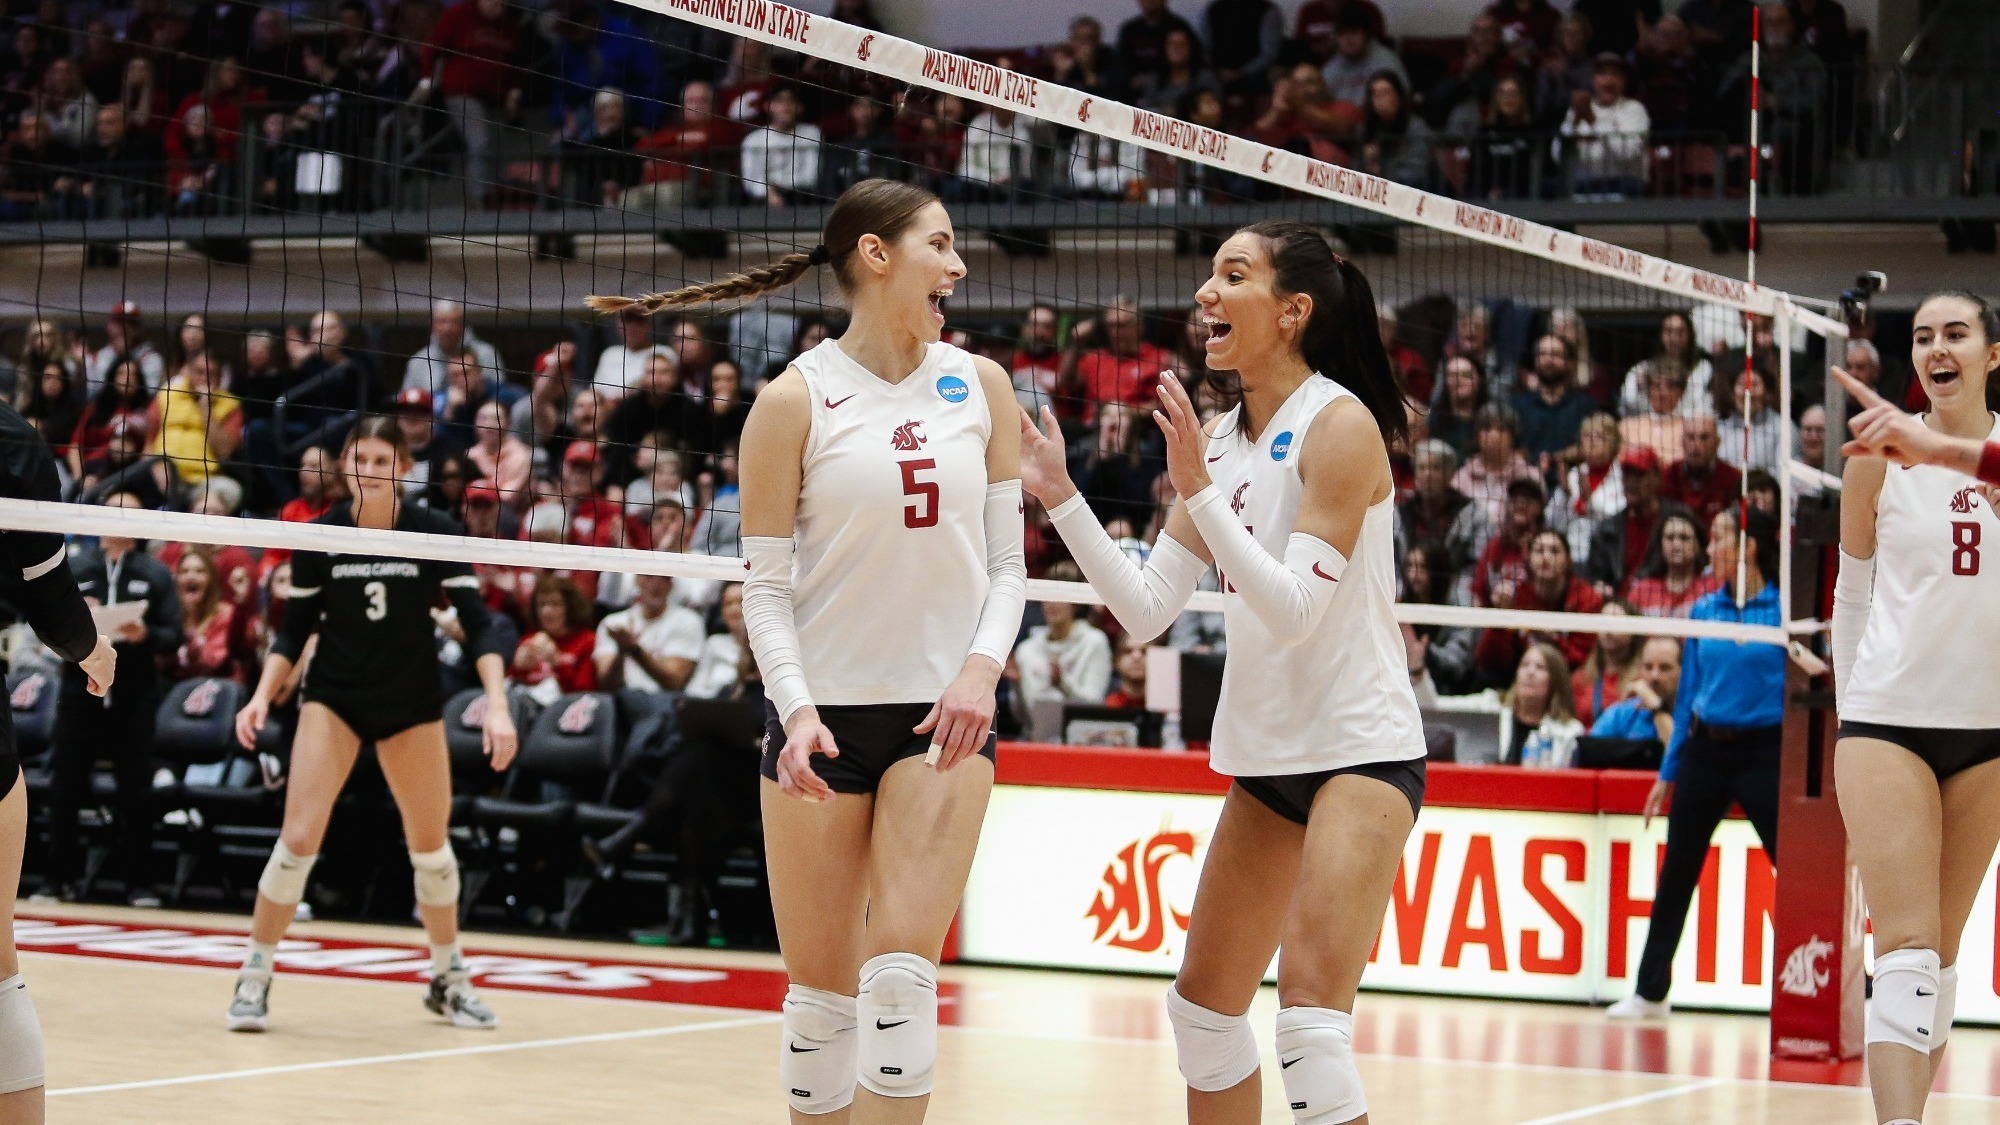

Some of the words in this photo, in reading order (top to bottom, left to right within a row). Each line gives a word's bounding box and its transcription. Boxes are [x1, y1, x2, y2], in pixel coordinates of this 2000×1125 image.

[768, 4, 810, 43] STATE
[922, 48, 1001, 97] WASHINGTON
[1005, 70, 1037, 108] STATE
[1132, 108, 1198, 151] WASHINGTON
[1198, 130, 1228, 161] STATE
[941, 386, 967, 396] NCAA
[896, 458, 939, 528] 5
[1950, 521, 1981, 575] 8
[364, 581, 387, 621] 3
